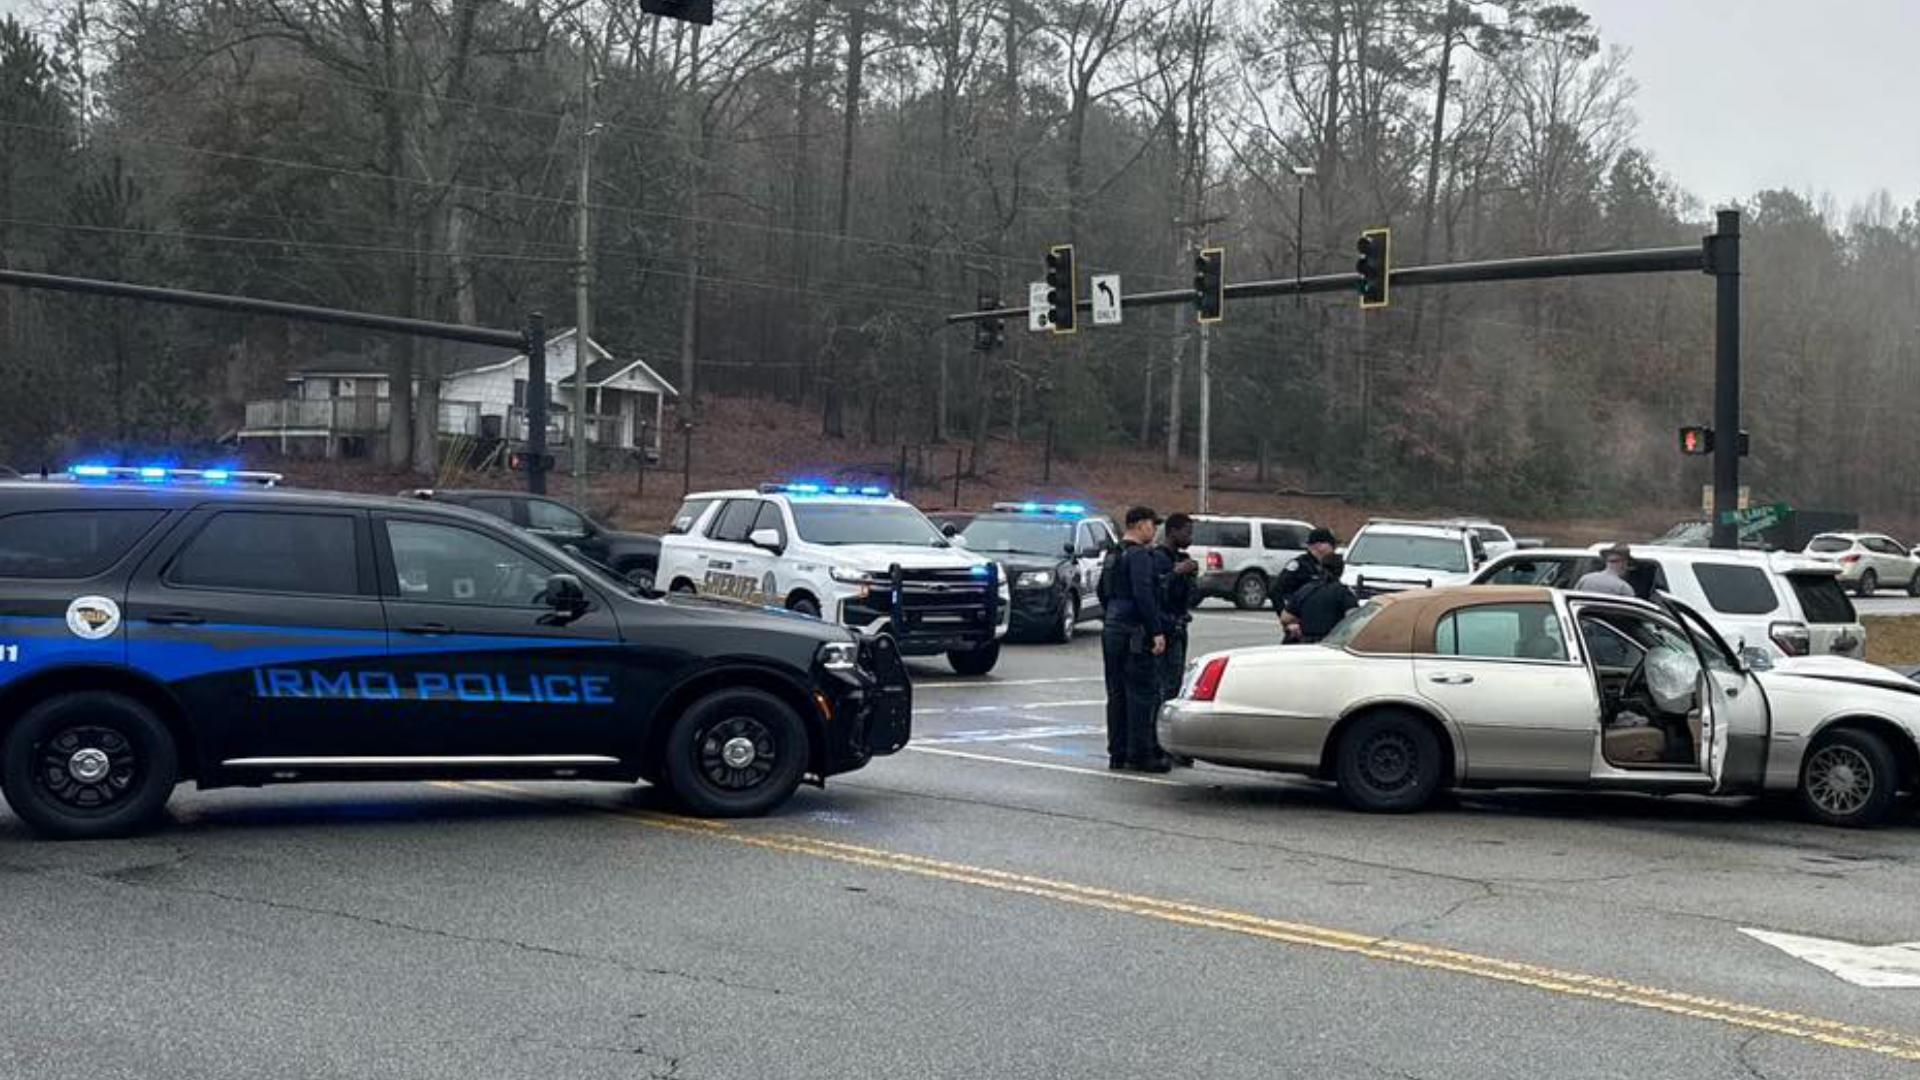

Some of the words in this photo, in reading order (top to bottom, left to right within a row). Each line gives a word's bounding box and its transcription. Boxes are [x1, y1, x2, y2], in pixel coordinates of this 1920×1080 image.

[1096, 309, 1117, 320] ONLY
[704, 570, 758, 598] SHERIFF
[254, 668, 396, 699] IRMO
[415, 672, 614, 703] POLICE
